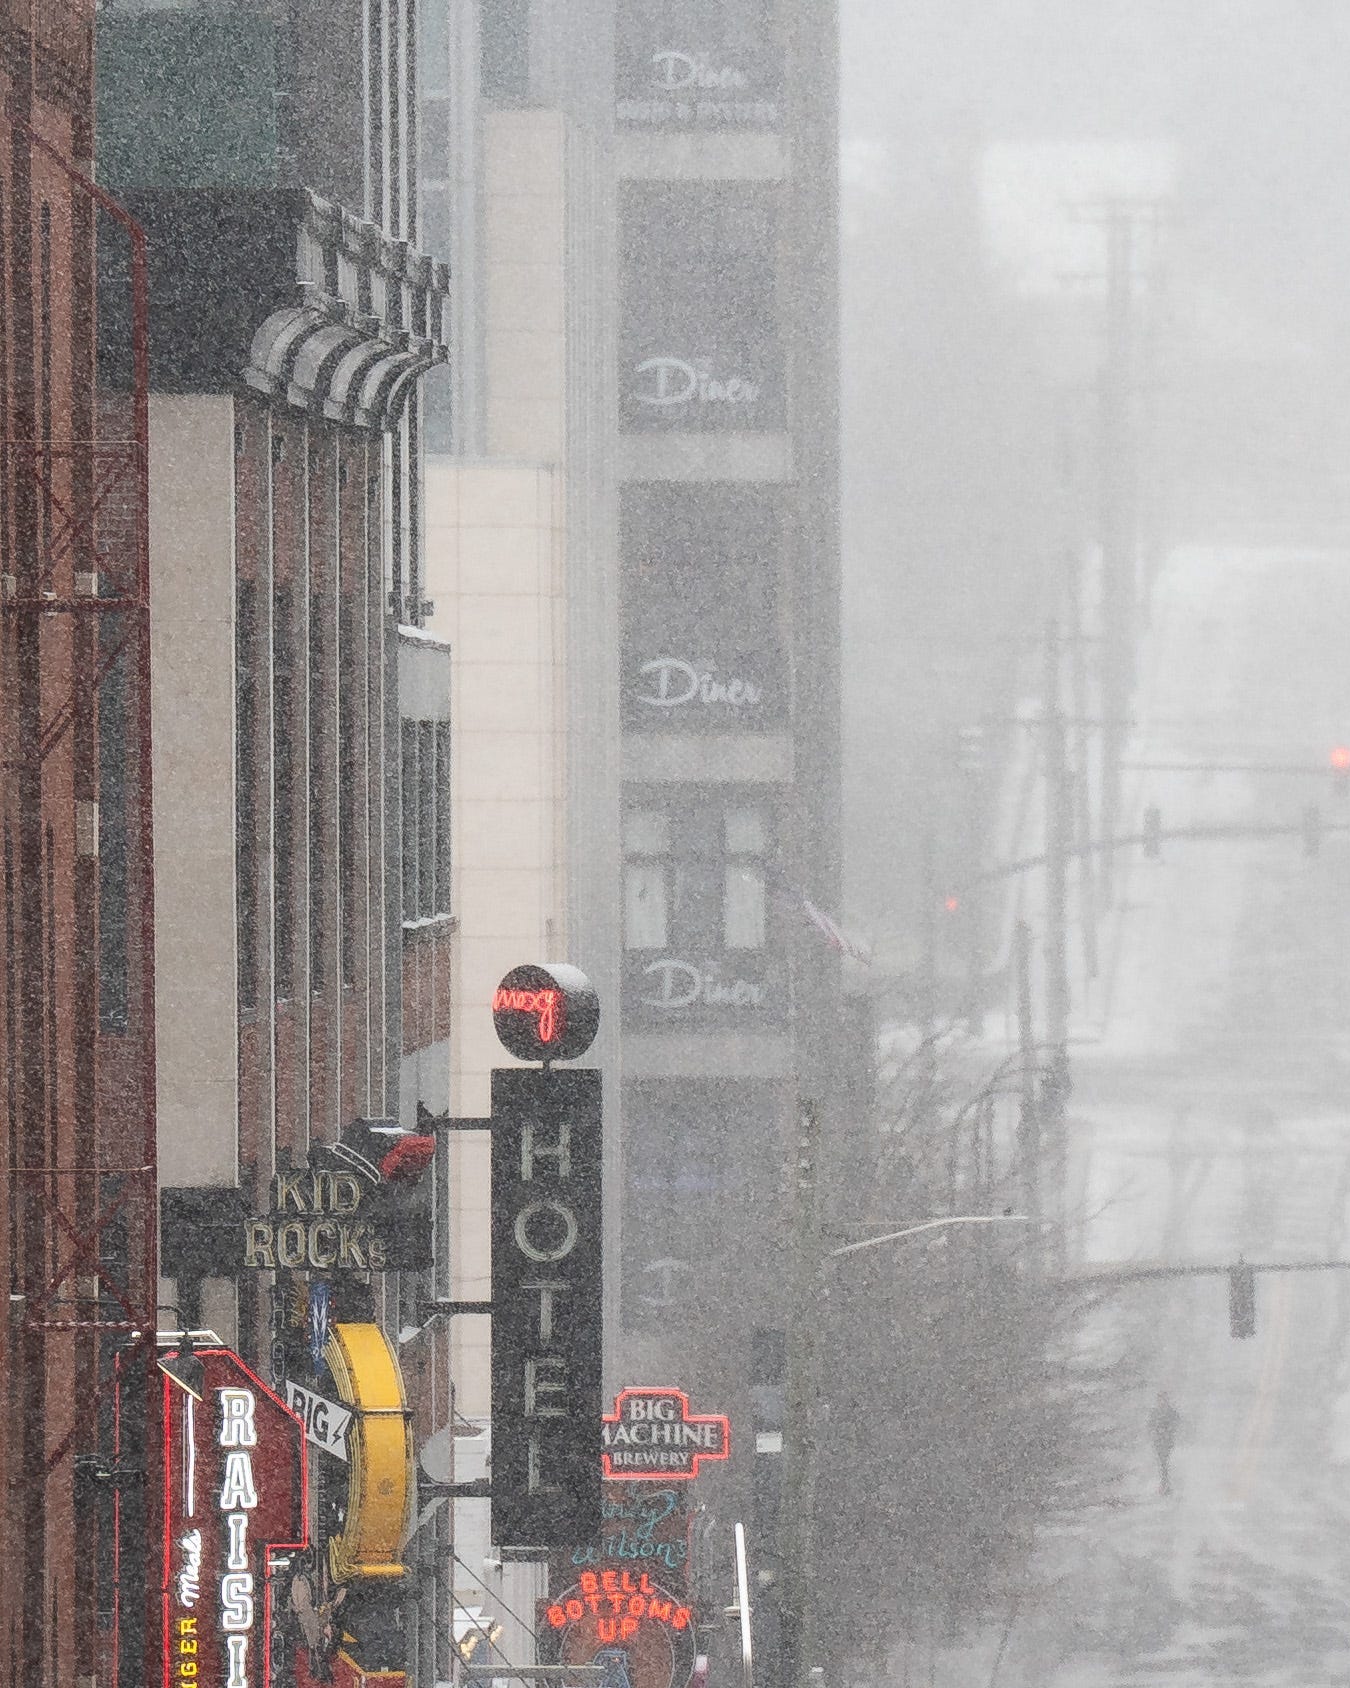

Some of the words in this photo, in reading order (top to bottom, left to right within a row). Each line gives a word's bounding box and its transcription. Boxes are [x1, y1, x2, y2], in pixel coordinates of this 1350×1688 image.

[635, 357, 760, 405] Diner
[638, 658, 763, 706] Diner
[641, 959, 766, 1007] Diner
[275, 1171, 361, 1214] KID
[514, 1124, 577, 1495] HOTEL
[292, 1389, 329, 1443] BIG
[630, 1399, 675, 1421] BIG
[613, 1451, 690, 1466] BREWERY
[580, 1570, 655, 1596] BELL
[547, 1591, 692, 1631] BOTTOMS
[597, 1617, 639, 1643] UP
